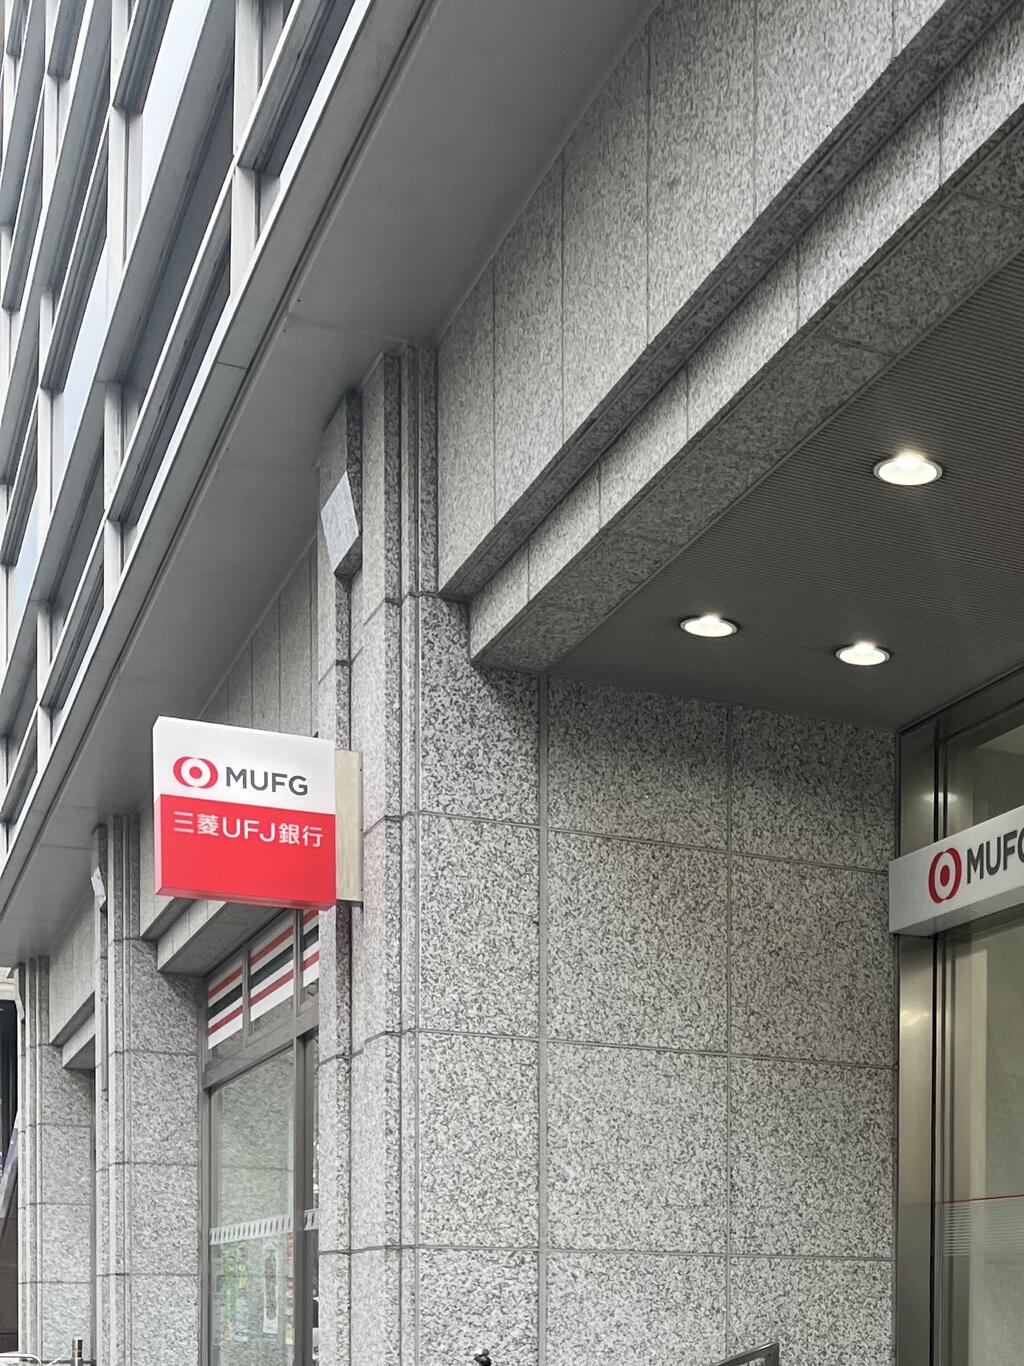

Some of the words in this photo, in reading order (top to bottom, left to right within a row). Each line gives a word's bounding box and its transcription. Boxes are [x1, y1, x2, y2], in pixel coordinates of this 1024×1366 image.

[226, 766, 308, 796] MUFG
[173, 811, 323, 847] 三菱UFJ銀行
